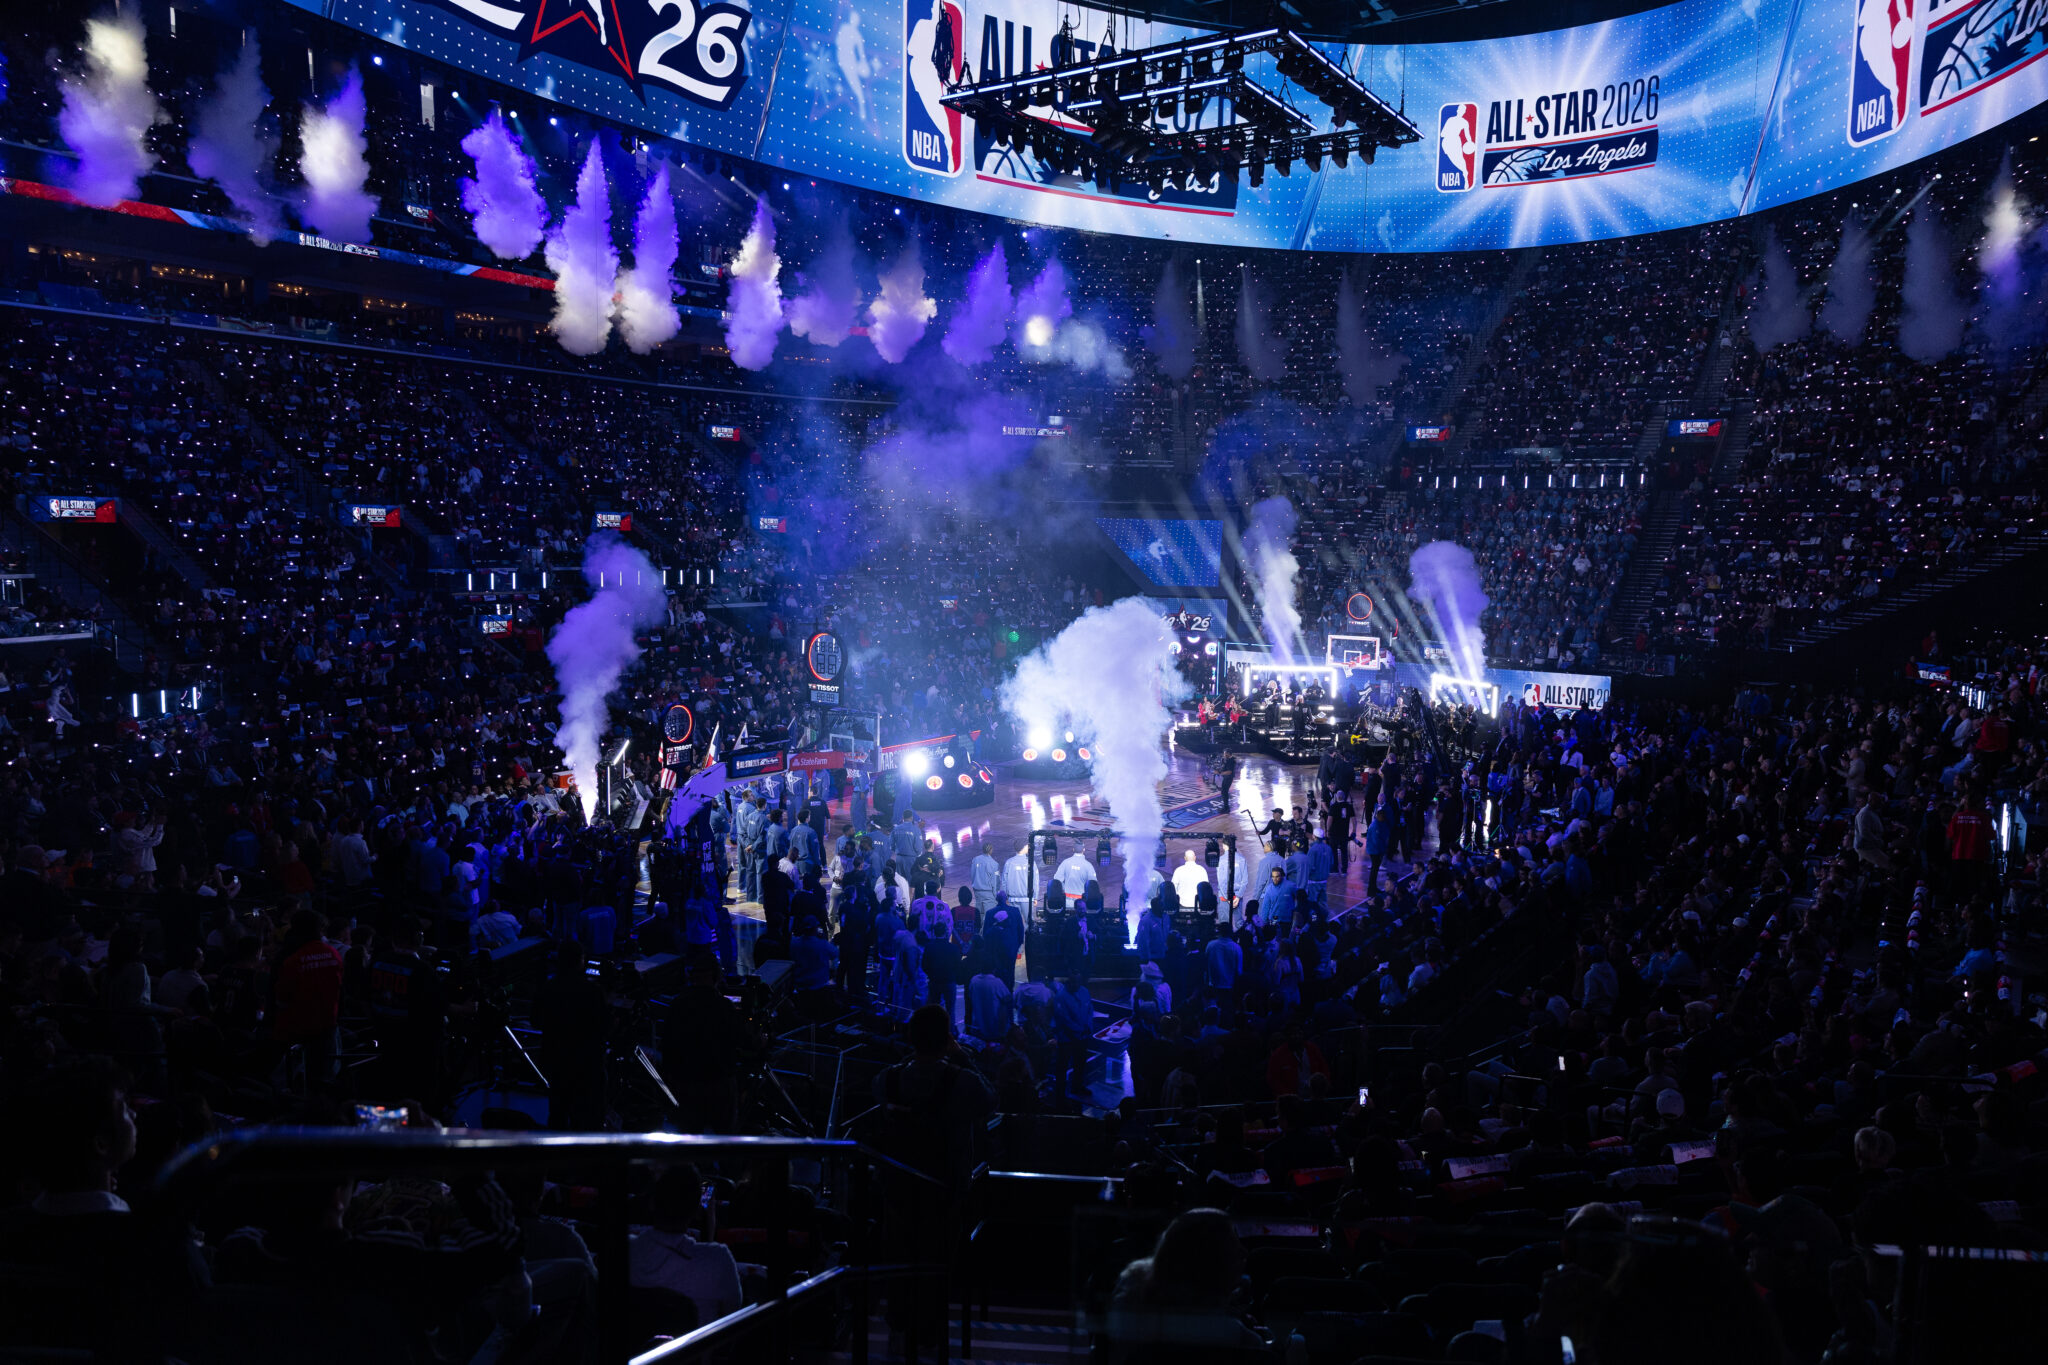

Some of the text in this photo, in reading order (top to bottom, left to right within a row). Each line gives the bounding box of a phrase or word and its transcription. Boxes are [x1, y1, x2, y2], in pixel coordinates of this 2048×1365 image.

[637, 0, 742, 103] 26
[1486, 75, 1660, 144] ALL STAR 2026
[1856, 94, 1886, 134] NBA
[912, 130, 942, 163] NBA
[1539, 137, 1648, 172] Los Angeles
[1441, 172, 1461, 187] NBA
[306, 235, 316, 247] ALL
[316, 237, 330, 250] STAR
[1191, 616, 1211, 631] 26
[1544, 685, 1562, 704] ALL
[1566, 687, 1594, 707] STAR
